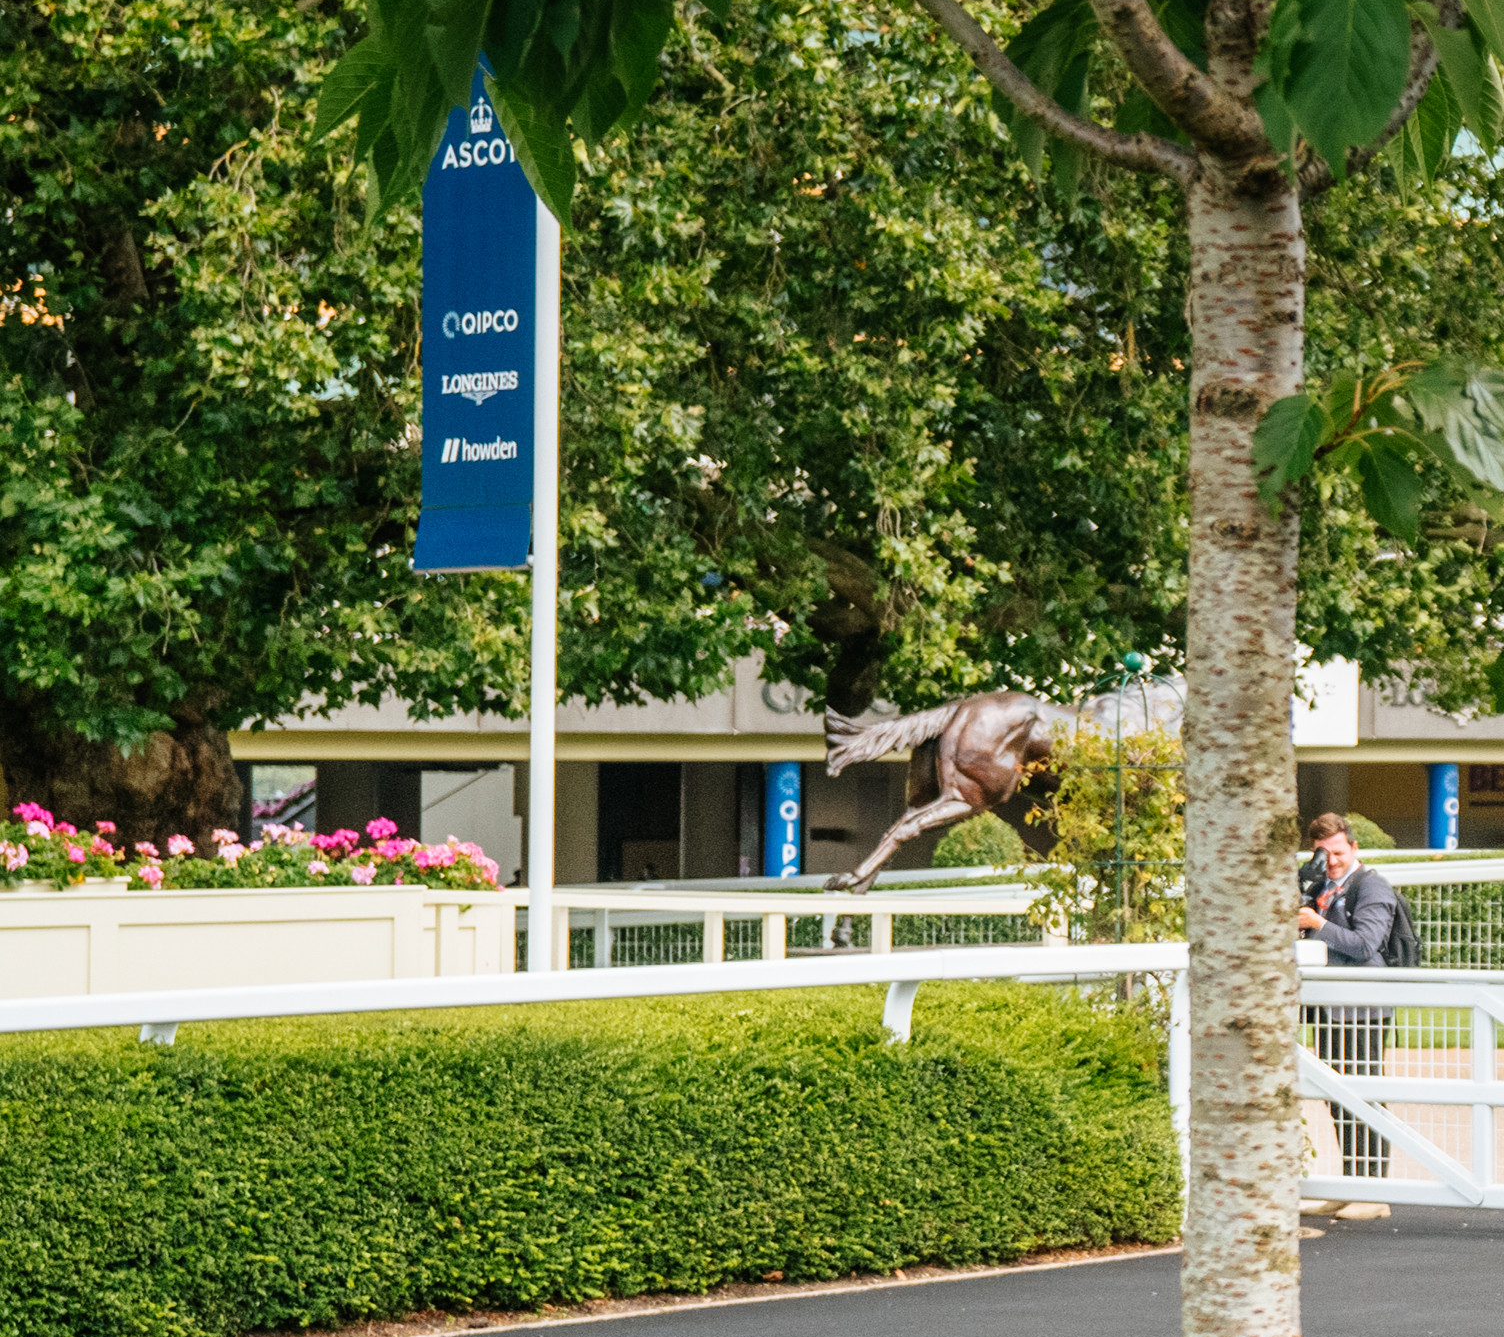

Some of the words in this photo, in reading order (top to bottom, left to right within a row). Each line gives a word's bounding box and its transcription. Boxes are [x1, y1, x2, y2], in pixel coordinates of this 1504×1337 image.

[461, 308, 519, 335] QIPCO
[441, 370, 519, 395] LONGINES
[461, 435, 518, 462] howden
